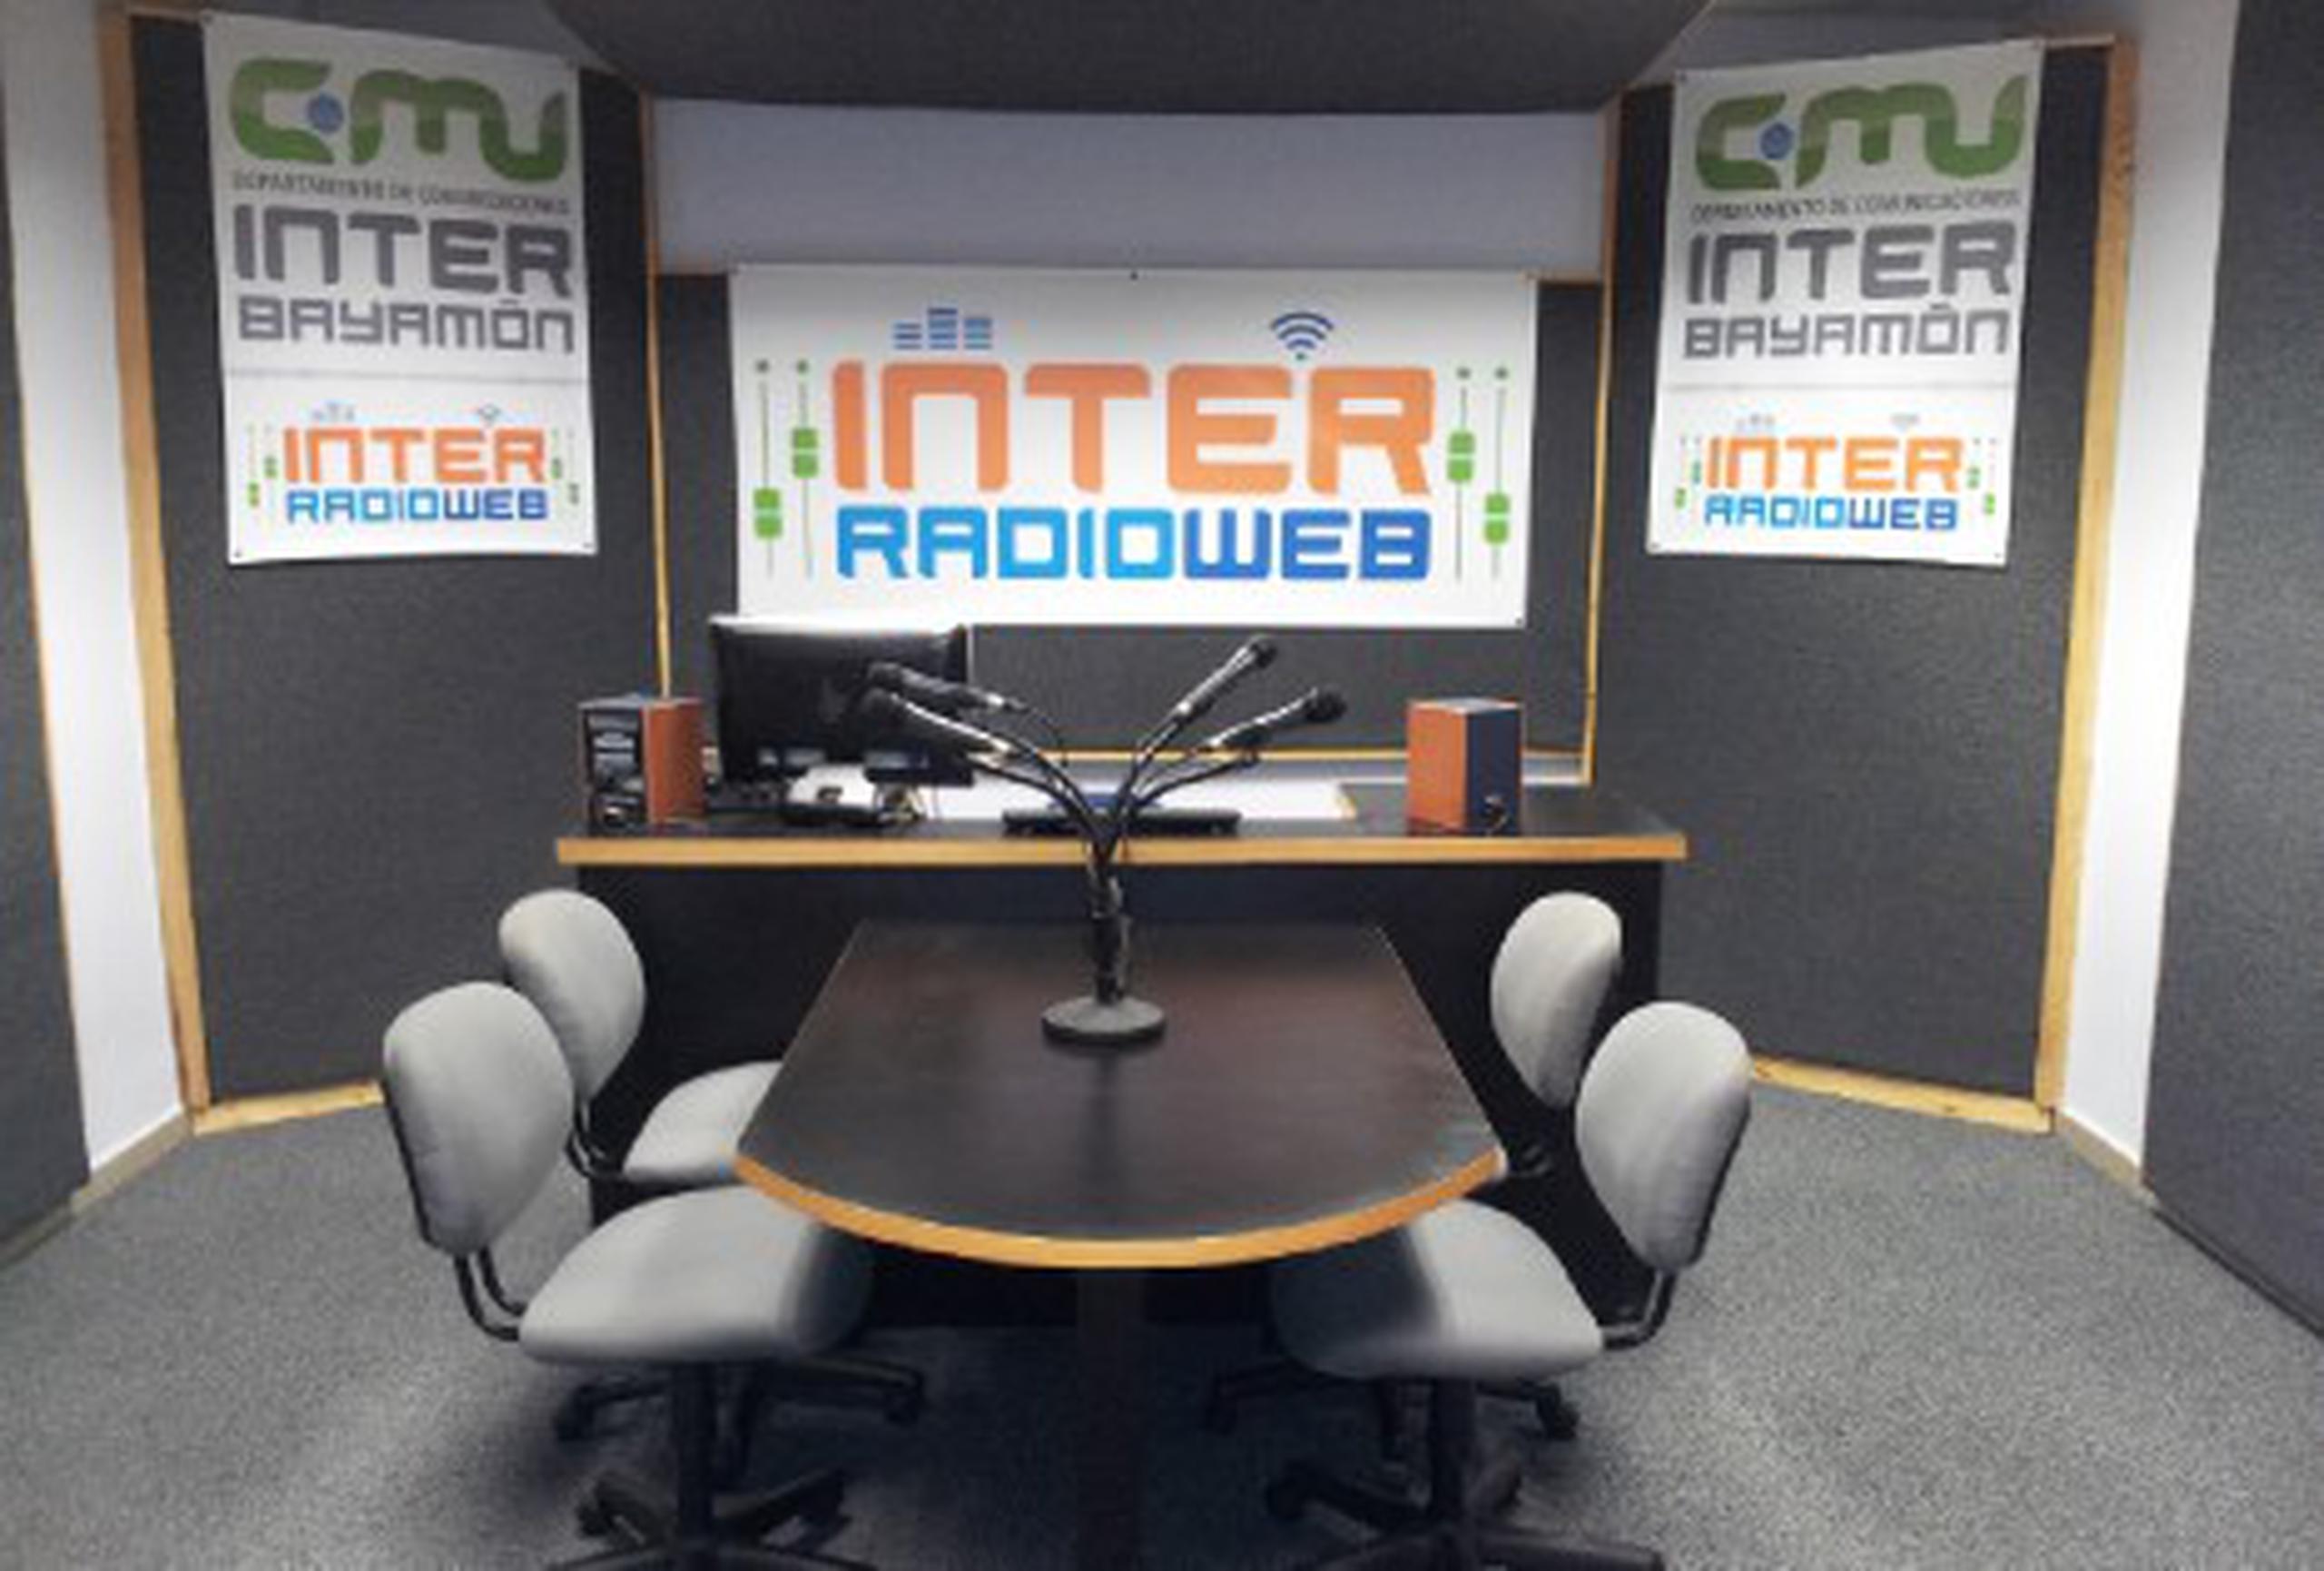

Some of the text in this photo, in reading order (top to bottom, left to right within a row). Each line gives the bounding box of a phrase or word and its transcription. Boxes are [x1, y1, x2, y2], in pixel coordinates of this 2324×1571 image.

[233, 204, 573, 298] INTER
[1688, 220, 2016, 304] INTER
[284, 427, 546, 483] INTER
[832, 360, 1435, 496] INTER
[1704, 437, 1965, 493] INTER
[286, 488, 547, 523] RADIOWEB
[1704, 495, 1958, 531] RADIOWEB
[836, 506, 1433, 580] RADIOWEB
